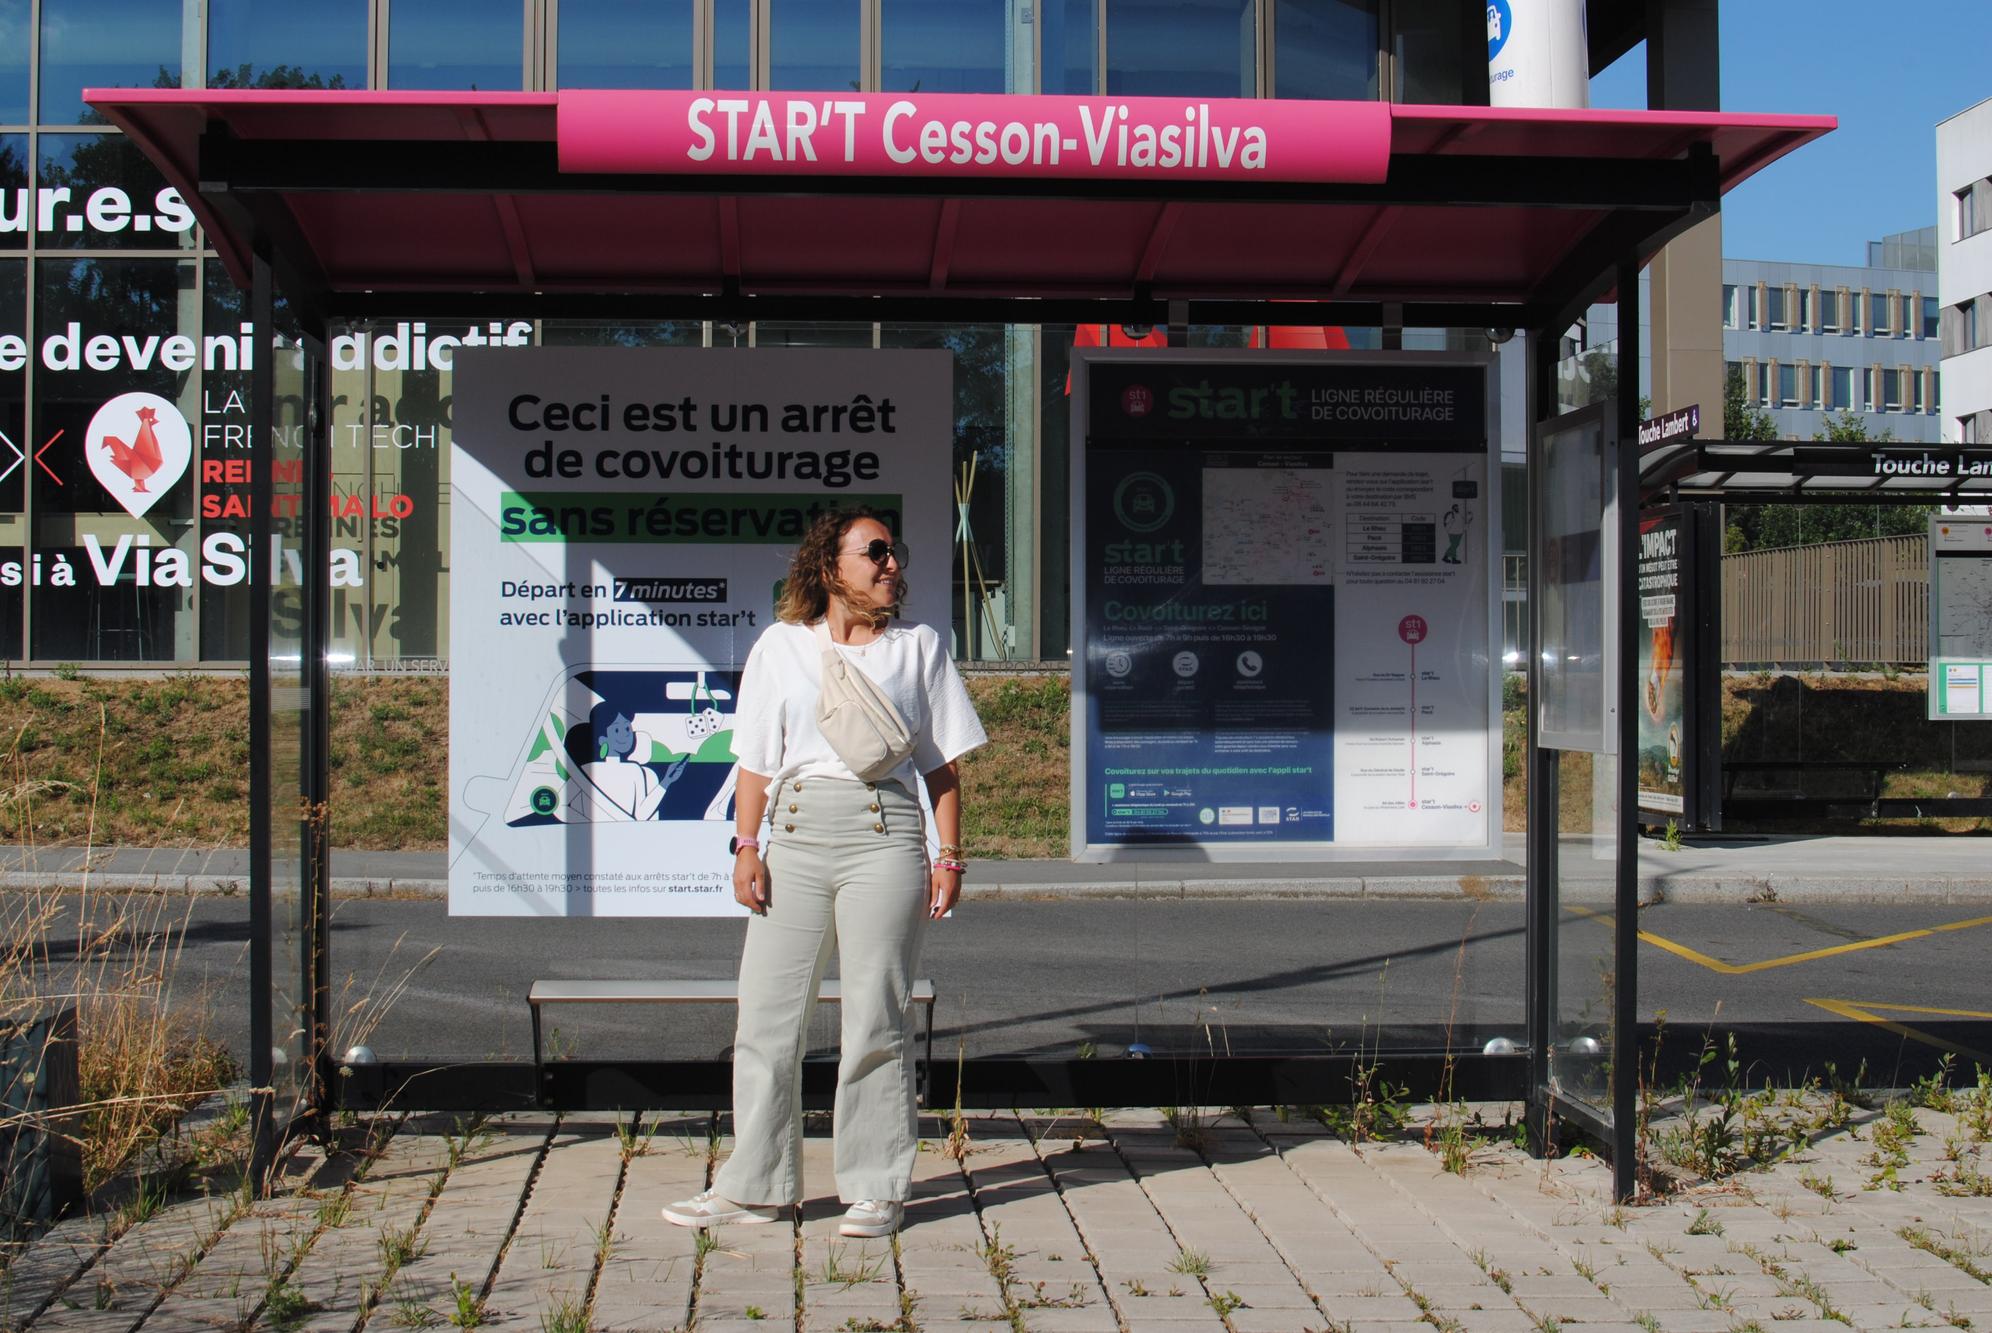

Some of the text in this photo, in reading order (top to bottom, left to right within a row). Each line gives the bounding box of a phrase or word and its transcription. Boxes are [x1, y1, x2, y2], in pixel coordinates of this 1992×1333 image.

[687, 97, 1267, 170] STAR'T Cesson-Viasilva
[205, 390, 245, 414] LA
[1167, 379, 1297, 420] star't
[1311, 386, 1456, 404] LIGNE RÉGULIÈRE
[508, 394, 897, 434] Ceci est un arrêt
[1311, 406, 1456, 422] DE COVOITURAGE
[1661, 412, 1689, 439] Lambert
[346, 425, 435, 449] TECH
[524, 440, 880, 488] de covoiturage
[1871, 453, 1950, 475] Touche
[501, 496, 901, 538] sans réservatn
[1104, 539, 1184, 564] star't
[1639, 529, 1677, 560] 'IMPACT
[1104, 566, 1134, 574] LIGNE
[1104, 576, 1185, 585] DE COVOITURAGE
[501, 580, 576, 602] Départ
[583, 584, 607, 599] en
[614, 581, 626, 599] 7
[500, 609, 756, 630] avec l'application star't
[1103, 600, 1268, 622] Covoiturez ici
[473, 884, 493, 894] puis
[493, 884, 505, 893] de
[583, 884, 612, 893] toutes
[629, 884, 652, 893] infos
[668, 883, 724, 893] start.star.fr
[552, 873, 582, 883] moyen
[583, 872, 623, 881] constaté
[625, 873, 641, 881] aux
[697, 872, 709, 881] de
